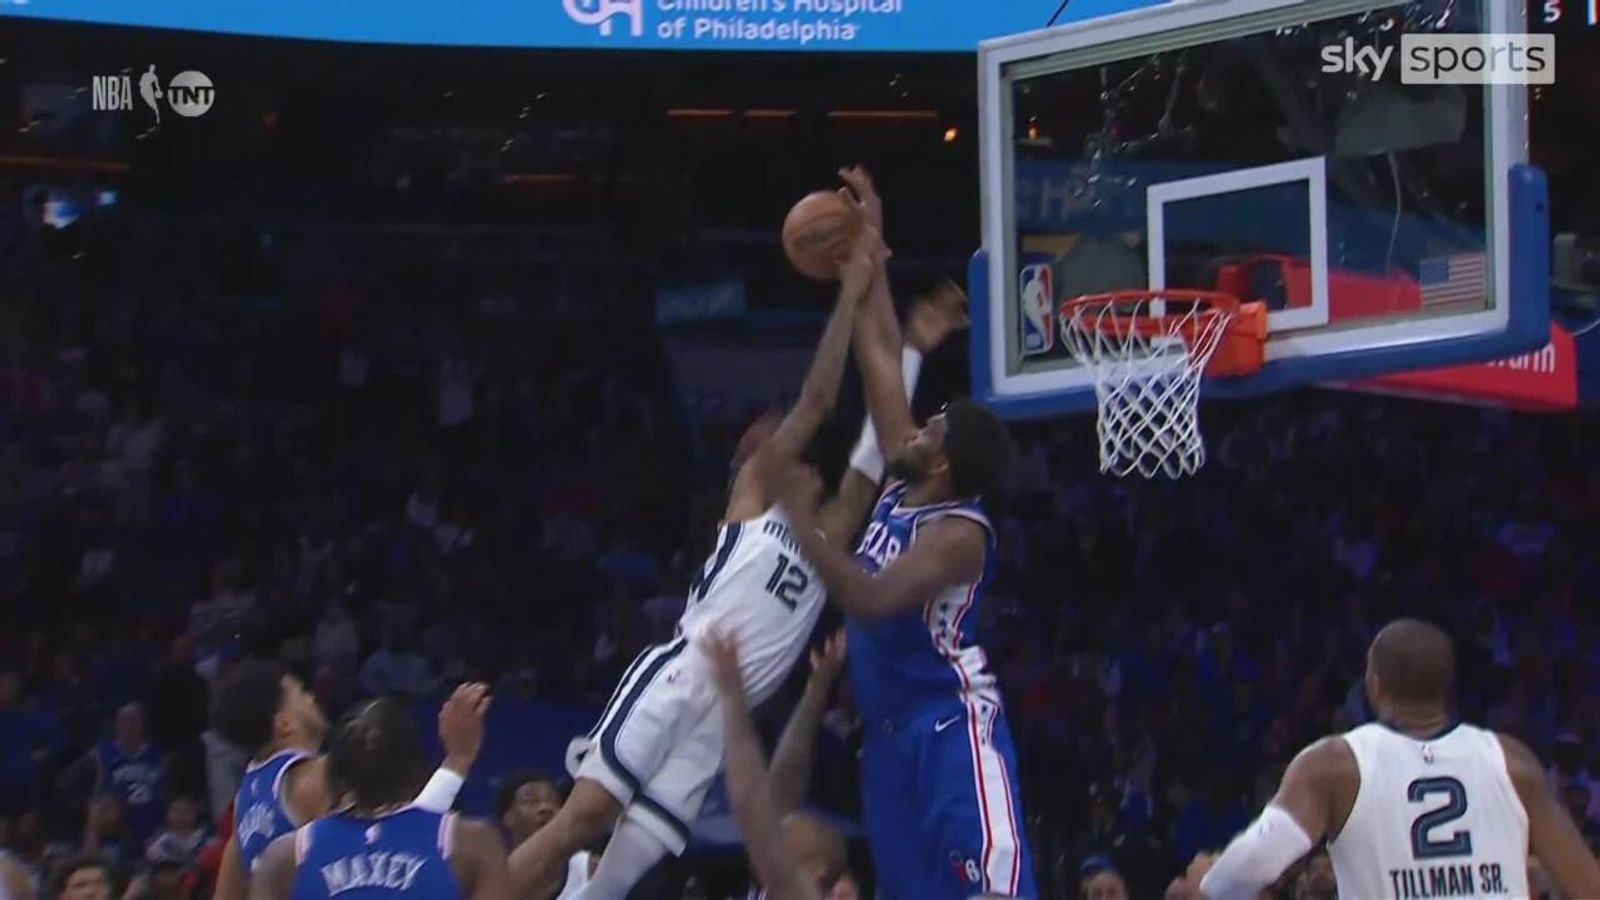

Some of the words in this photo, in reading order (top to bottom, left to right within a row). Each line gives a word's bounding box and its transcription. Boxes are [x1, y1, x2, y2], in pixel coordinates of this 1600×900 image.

[656, 0, 787, 12] Childrens
[793, 0, 902, 17] Hospital
[656, 17, 687, 39] of
[694, 17, 856, 46] Philadelphia
[765, 553, 808, 614] 12
[1407, 776, 1473, 860] 2
[321, 851, 428, 897] MAXEY
[1389, 864, 1475, 900] TILLMAN
[1479, 863, 1509, 894] SR.
